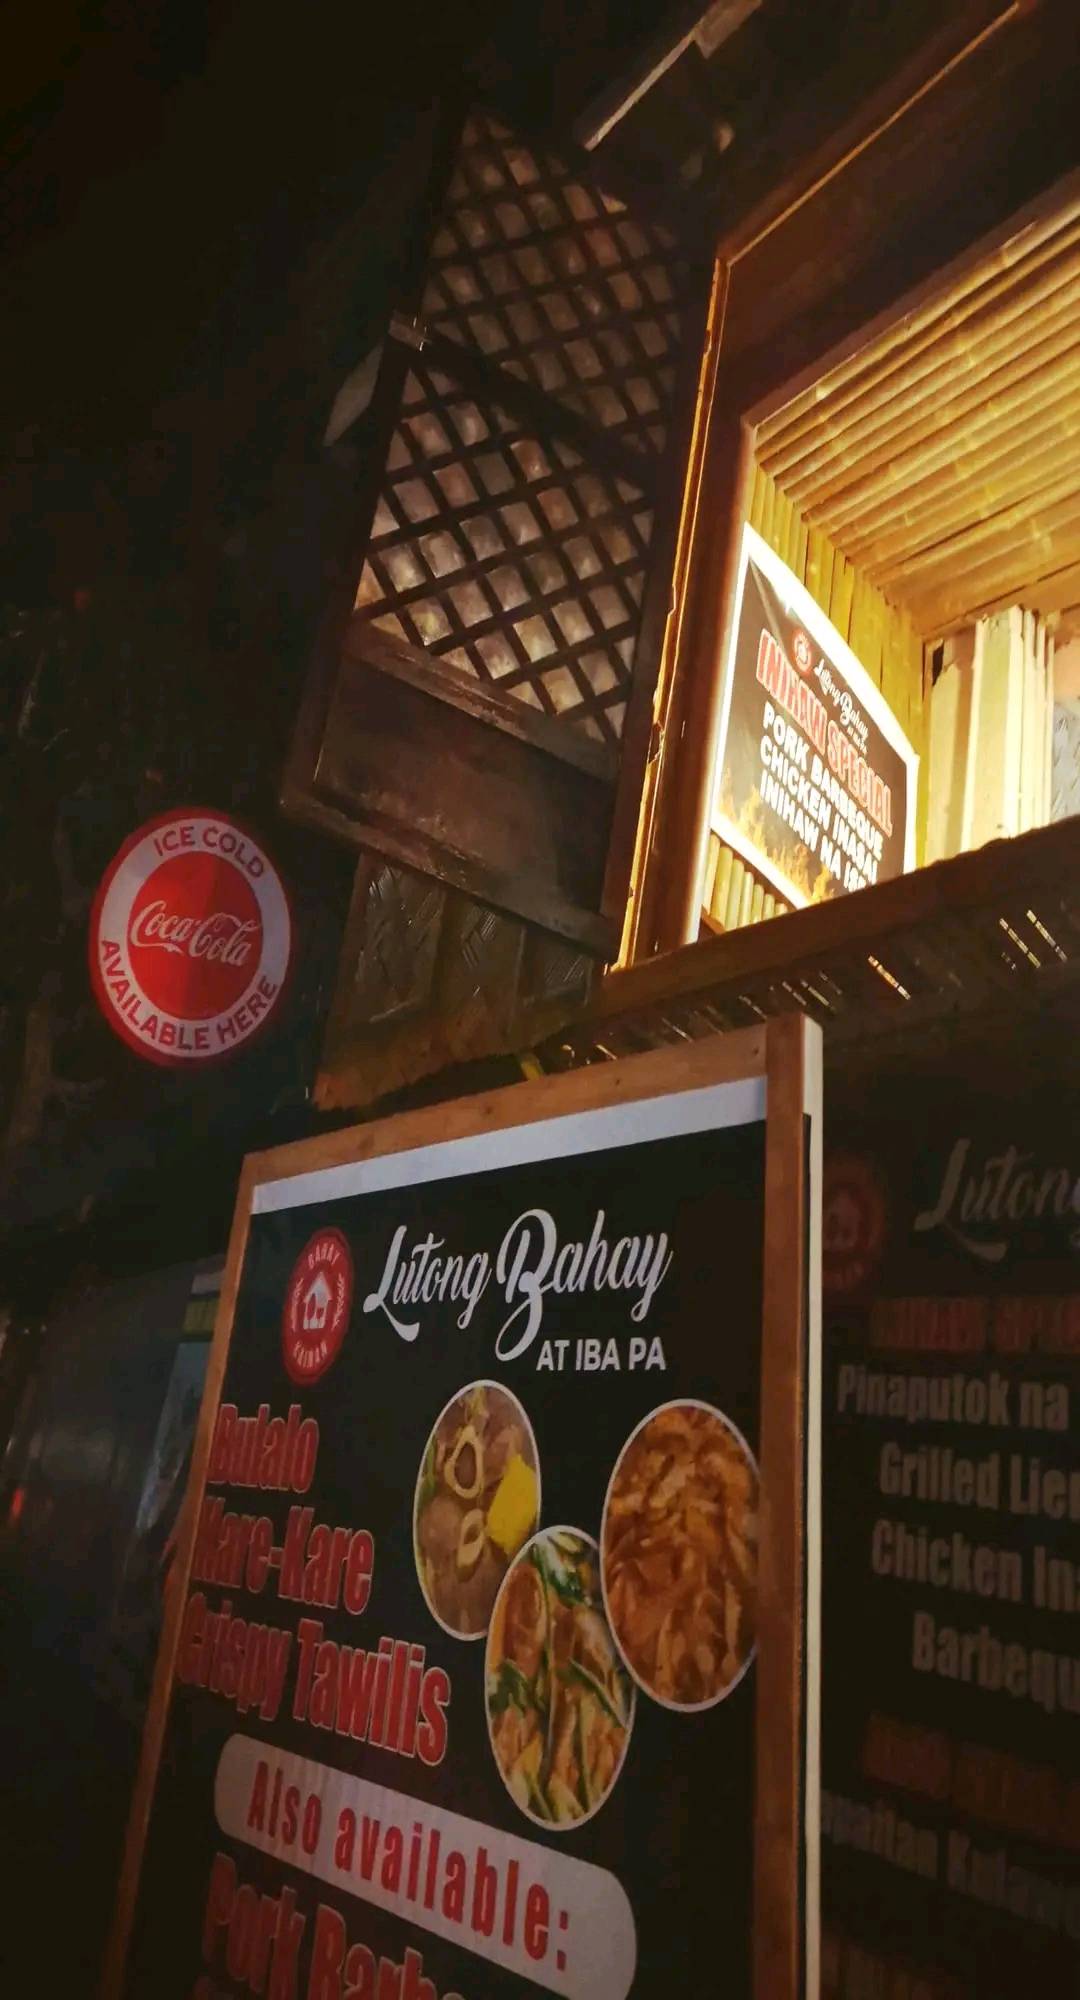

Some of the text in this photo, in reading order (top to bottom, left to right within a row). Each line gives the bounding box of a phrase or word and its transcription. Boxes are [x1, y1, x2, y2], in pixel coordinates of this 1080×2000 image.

[756, 628, 893, 837] INIHAW SPECIAL
[760, 735, 832, 831] CHICKEN
[763, 701, 883, 861] PORK BARBEQUE
[154, 826, 265, 878] ICE COLD
[760, 769, 819, 853] INIHAW
[820, 839, 841, 881] NA
[130, 901, 258, 966] Coca-Cola
[102, 940, 277, 1050] AVAILABLE HERE
[363, 1225, 493, 1342] Lutong
[496, 1209, 673, 1361] Bahay
[536, 1336, 666, 1371] AT IBA PA
[837, 1363, 1069, 1432] Pinaputok na
[207, 1403, 319, 1493] Bulalo
[880, 1441, 999, 1511] Grilled
[192, 1496, 374, 1615] Kare-Kare
[872, 1518, 1023, 1602] Chicken
[176, 1592, 451, 1766] Crispy Tawilis
[247, 1761, 568, 1971] Also available:
[201, 1851, 305, 2000] Pork
